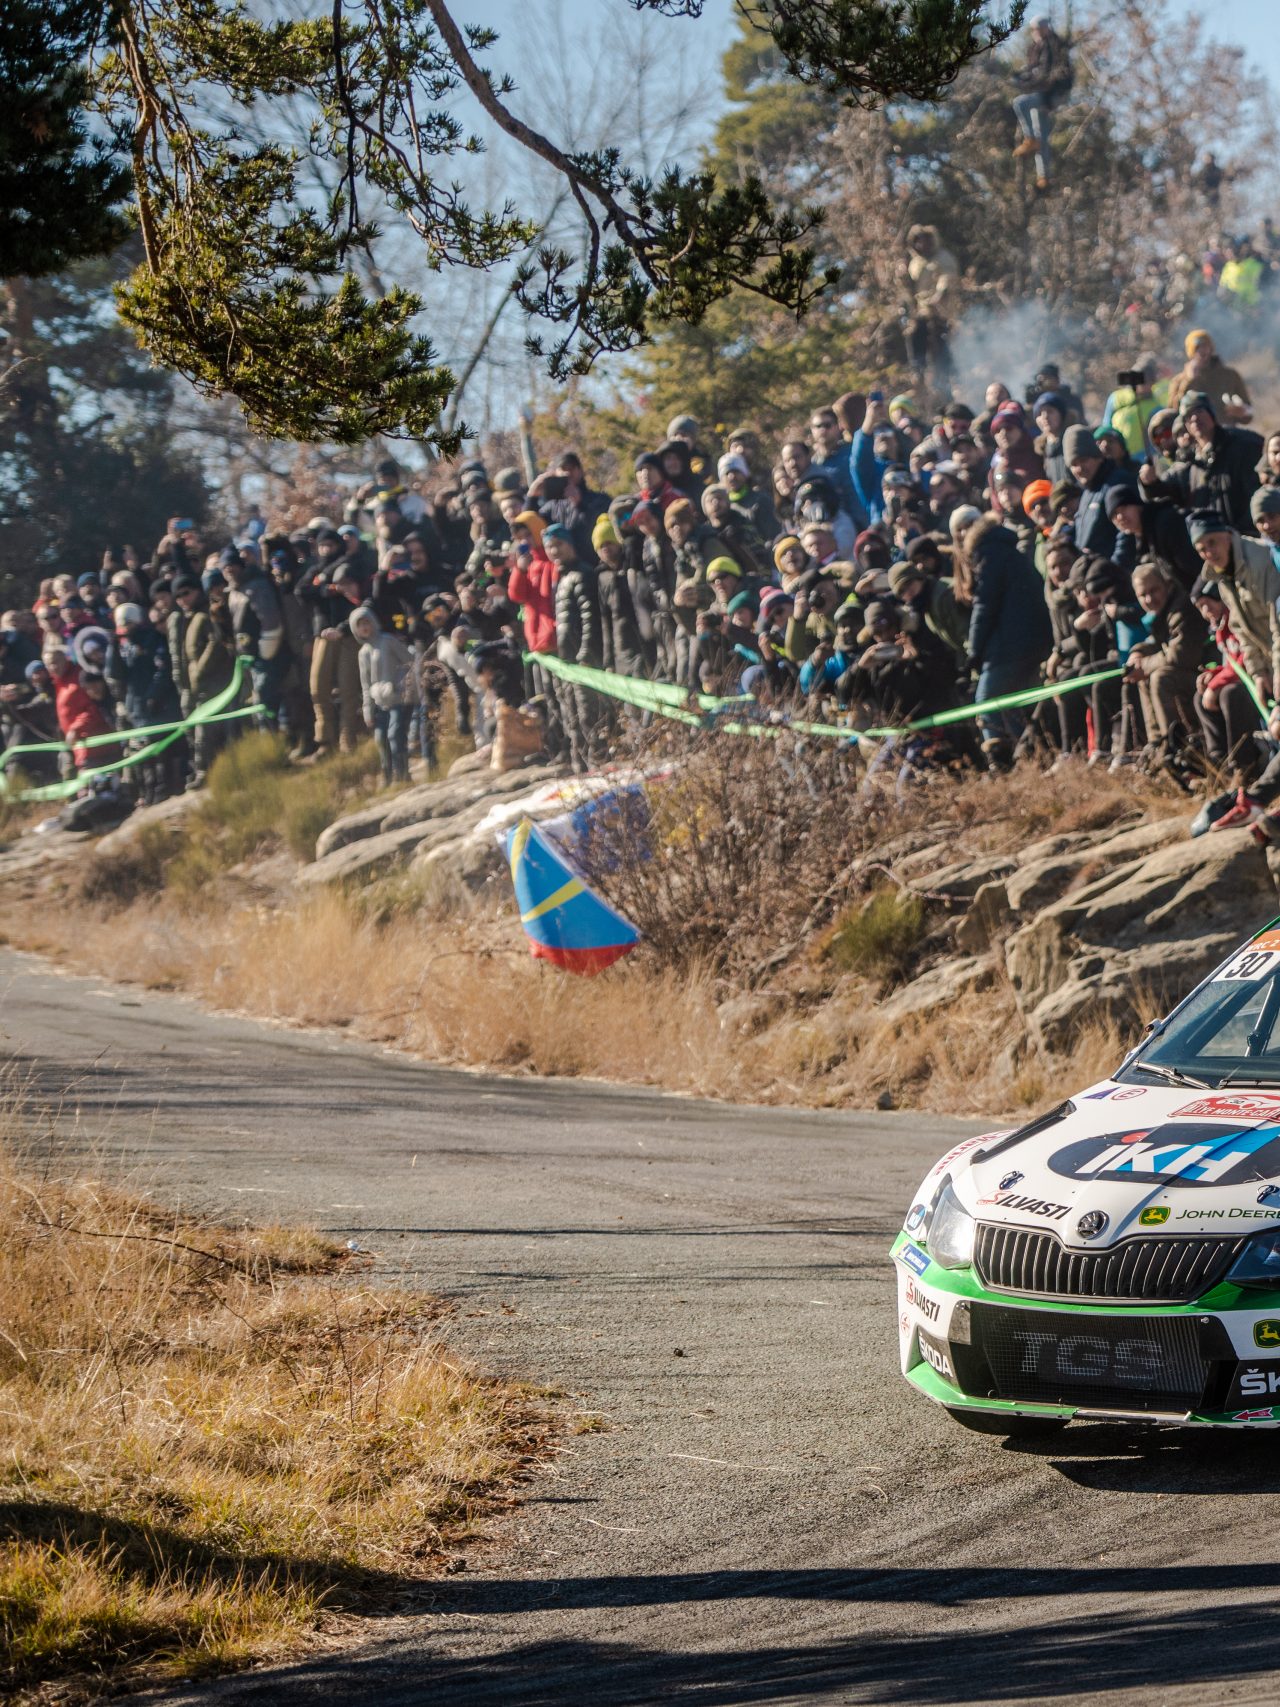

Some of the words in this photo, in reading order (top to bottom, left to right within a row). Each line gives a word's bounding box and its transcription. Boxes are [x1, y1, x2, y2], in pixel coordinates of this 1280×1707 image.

[1269, 938, 1278, 948] 2
[1224, 951, 1275, 979] 30
[1175, 1210, 1227, 1220] JOHN
[1012, 1331, 1165, 1380] TGS
